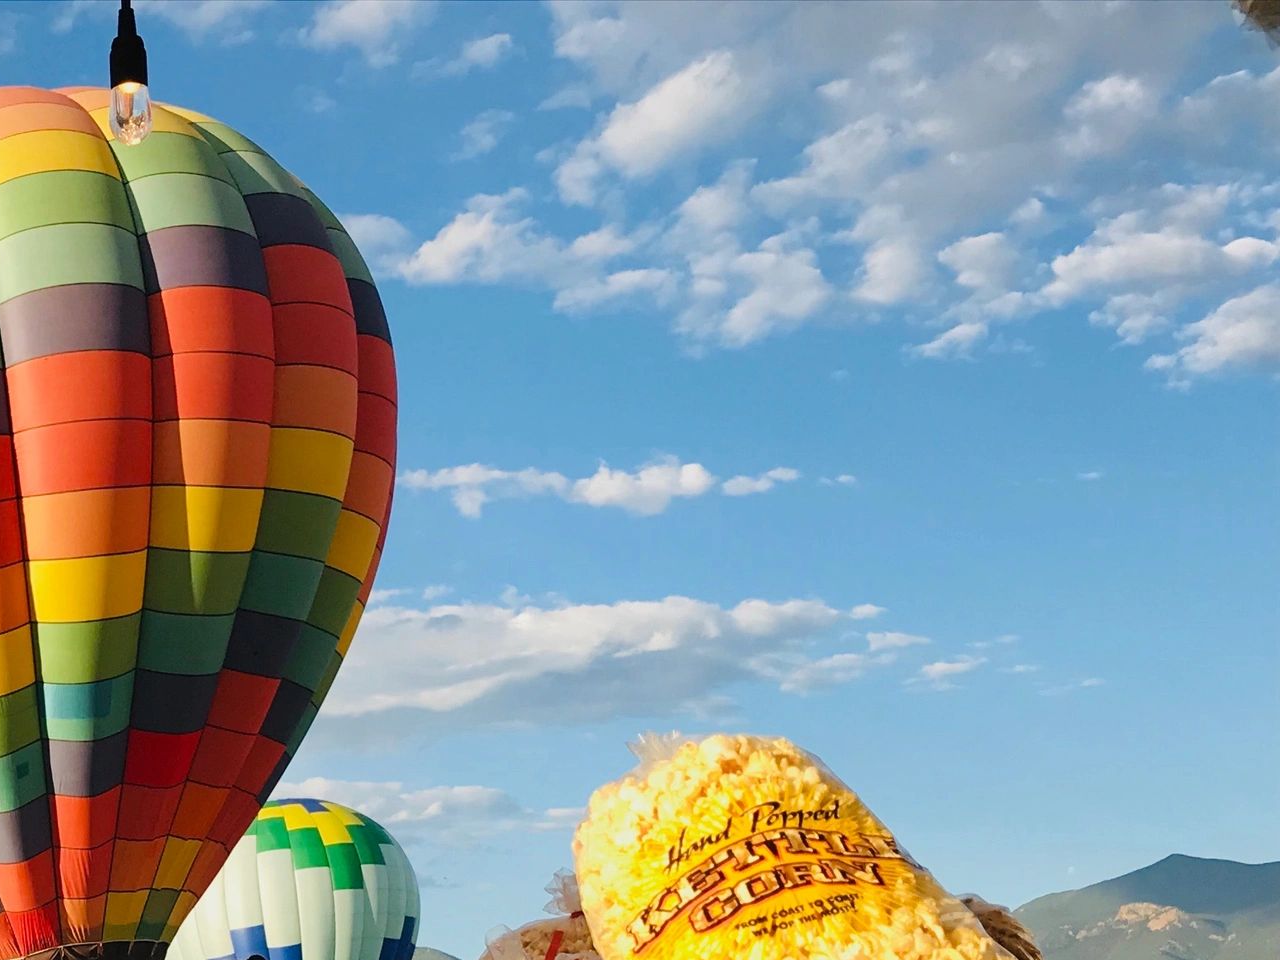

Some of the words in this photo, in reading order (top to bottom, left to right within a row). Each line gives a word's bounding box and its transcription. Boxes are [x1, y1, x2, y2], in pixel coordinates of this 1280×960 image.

[663, 817, 732, 875] Hand
[688, 858, 887, 934] CORN
[734, 914, 769, 930] FROM
[770, 904, 805, 920] COAST
[808, 899, 824, 908] TO
[751, 926, 769, 937] WE
[798, 913, 819, 925] THE
